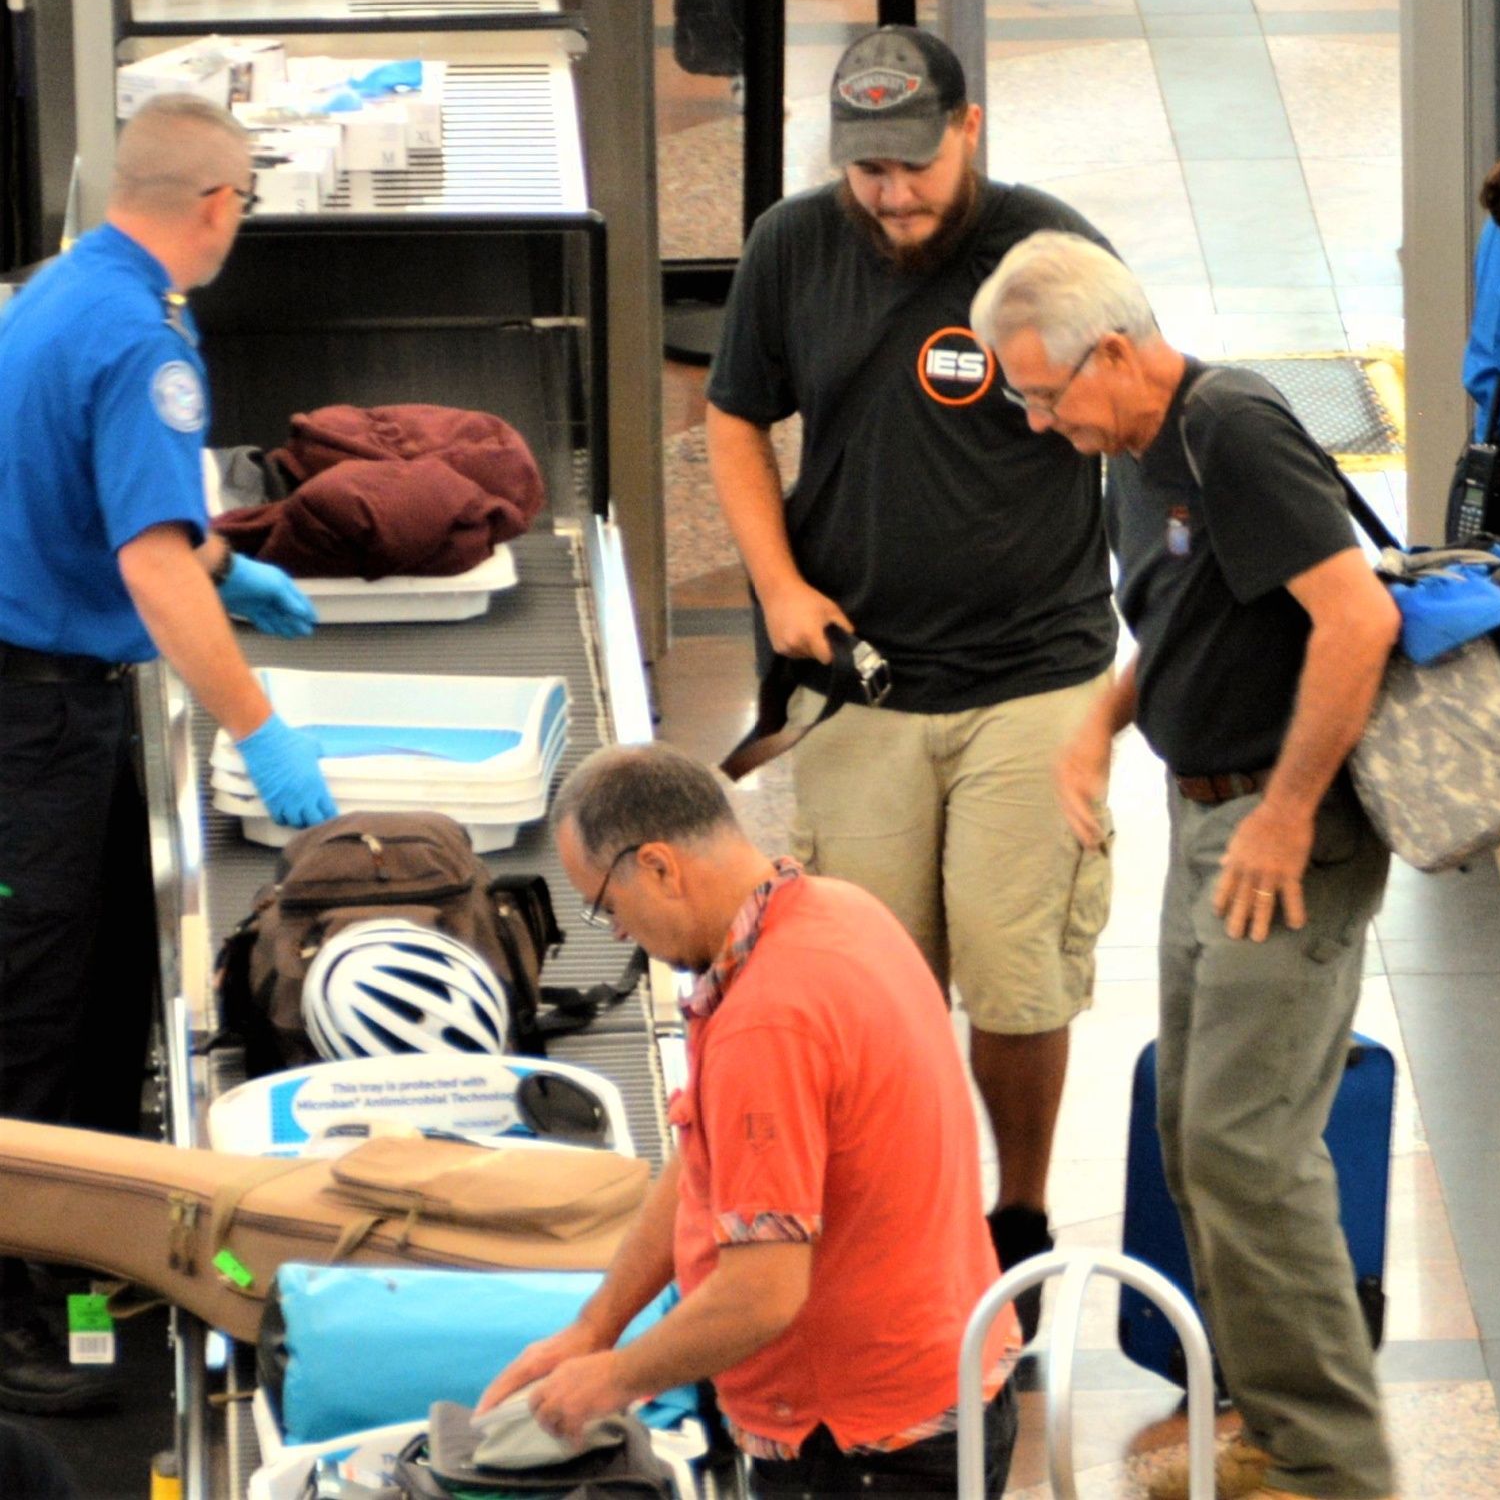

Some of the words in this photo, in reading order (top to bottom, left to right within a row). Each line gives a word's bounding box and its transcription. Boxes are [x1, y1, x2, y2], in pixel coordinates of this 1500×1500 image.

[382, 150, 395, 165] M
[926, 348, 985, 382] IES
[331, 1081, 358, 1094] This
[359, 1082, 383, 1094] tray
[386, 1079, 397, 1091] is
[397, 1076, 458, 1092] protected
[459, 1076, 486, 1088] with
[364, 1093, 447, 1108] Antimicrobial
[451, 1090, 516, 1103] Technolog
